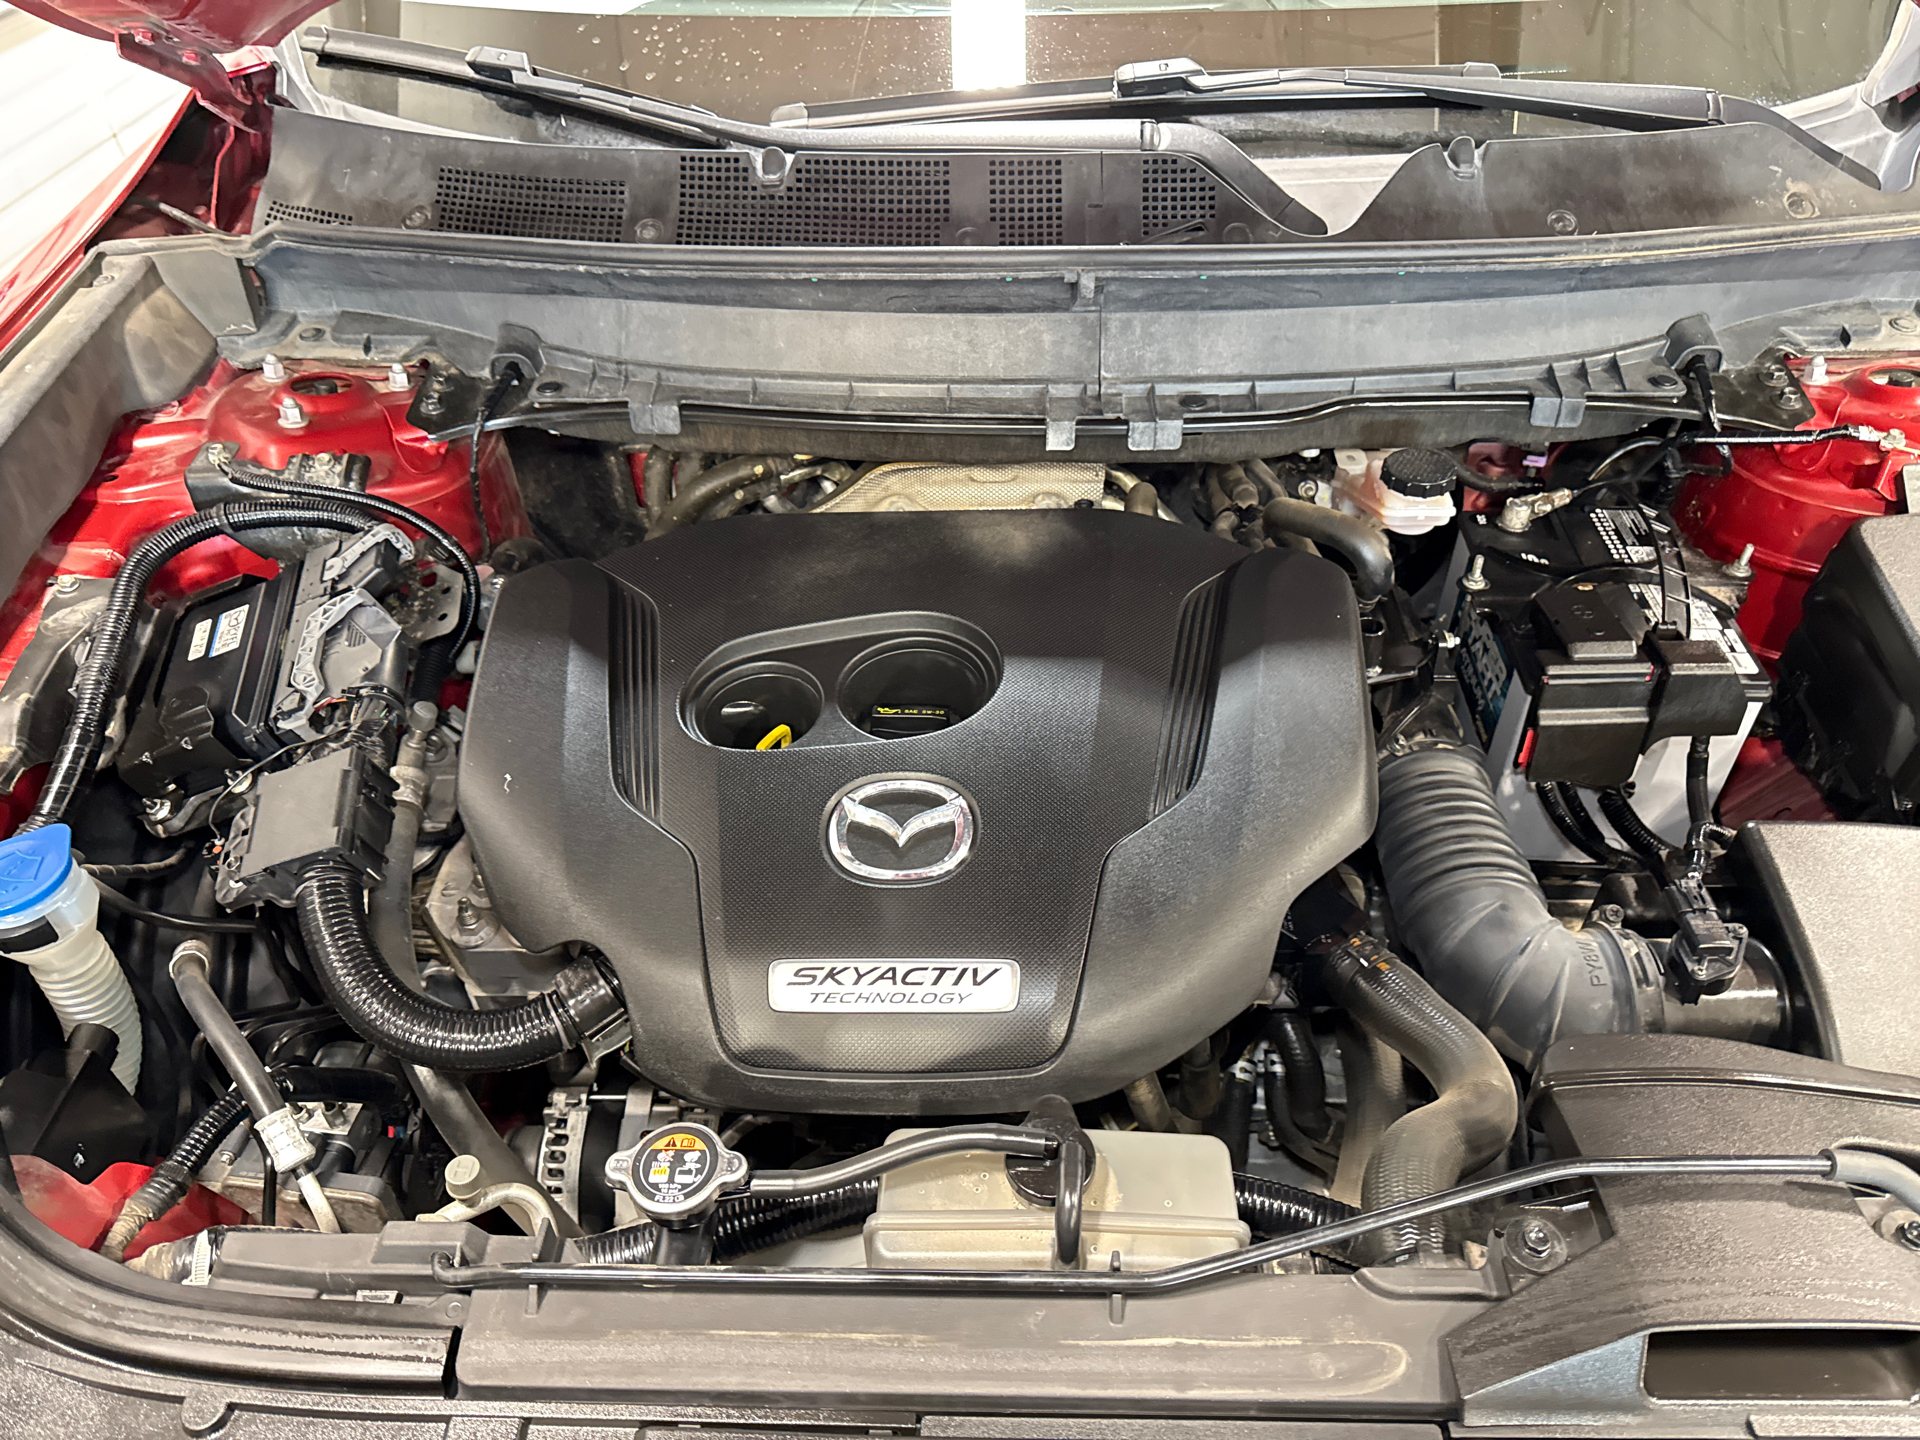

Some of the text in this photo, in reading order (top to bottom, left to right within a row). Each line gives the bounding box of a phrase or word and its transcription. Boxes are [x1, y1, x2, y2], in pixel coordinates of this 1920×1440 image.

[1576, 941, 1608, 987] PY8W
[786, 966, 1002, 987] SKYACTIV
[809, 992, 973, 1004] TECHNOLOGY
